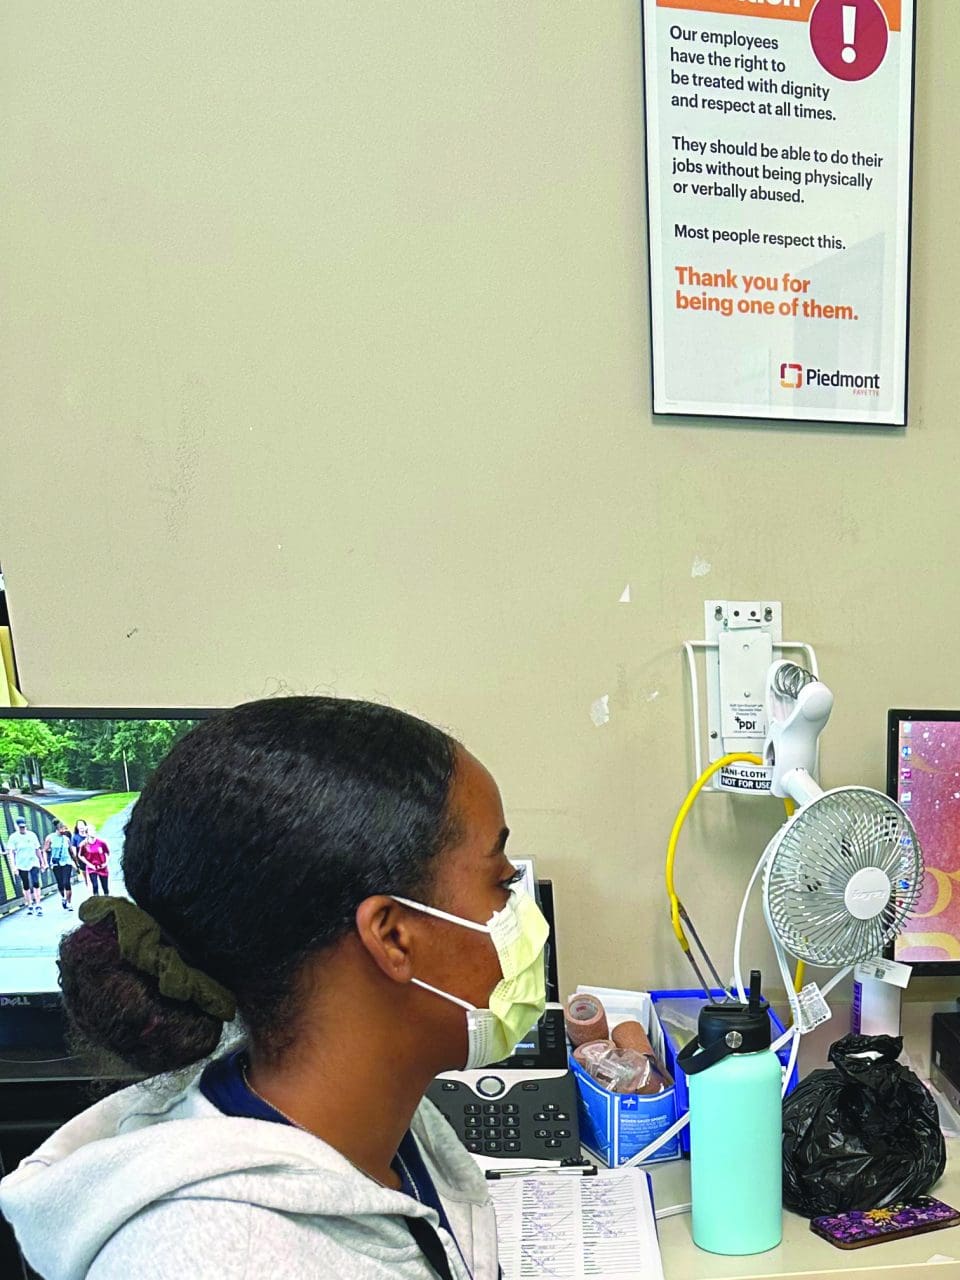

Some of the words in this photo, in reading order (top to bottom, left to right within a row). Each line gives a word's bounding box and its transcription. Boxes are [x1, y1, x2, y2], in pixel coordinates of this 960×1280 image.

[670, 26, 697, 42] Our
[701, 30, 778, 50] employees
[671, 48, 704, 64] have
[708, 50, 731, 67] the
[734, 53, 768, 71] right
[771, 59, 786, 72] to
[671, 70, 689, 85] be
[692, 73, 744, 90] treated
[748, 79, 778, 93] with
[781, 82, 829, 101] dignity
[671, 94, 698, 109] and
[701, 97, 755, 114] respect
[758, 103, 772, 115] at
[775, 102, 791, 116] all
[794, 104, 836, 121] times.
[672, 136, 707, 155] They
[710, 140, 757, 156] should
[761, 143, 778, 158] be
[781, 146, 810, 161] able
[814, 150, 827, 162] to
[831, 150, 848, 164] do
[852, 152, 883, 167] their
[672, 157, 702, 174] jobs
[706, 161, 759, 178] without
[763, 165, 801, 184] being
[805, 169, 873, 190] physically
[674, 183, 688, 194] or
[691, 182, 746, 201] verbally
[750, 187, 804, 203] abused.
[675, 224, 709, 240] Most
[712, 229, 760, 243] people
[763, 232, 815, 248] respect
[818, 235, 846, 249] this.
[675, 266, 738, 289] Thank
[742, 275, 778, 293] you
[782, 273, 810, 293] for
[676, 290, 733, 316] being
[737, 299, 774, 315] one
[779, 298, 798, 316] of
[803, 300, 858, 320] them.
[807, 369, 880, 389] Piedmont
[739, 720, 756, 730] PDI
[722, 777, 736, 786] NOT
[738, 779, 754, 788] FOR
